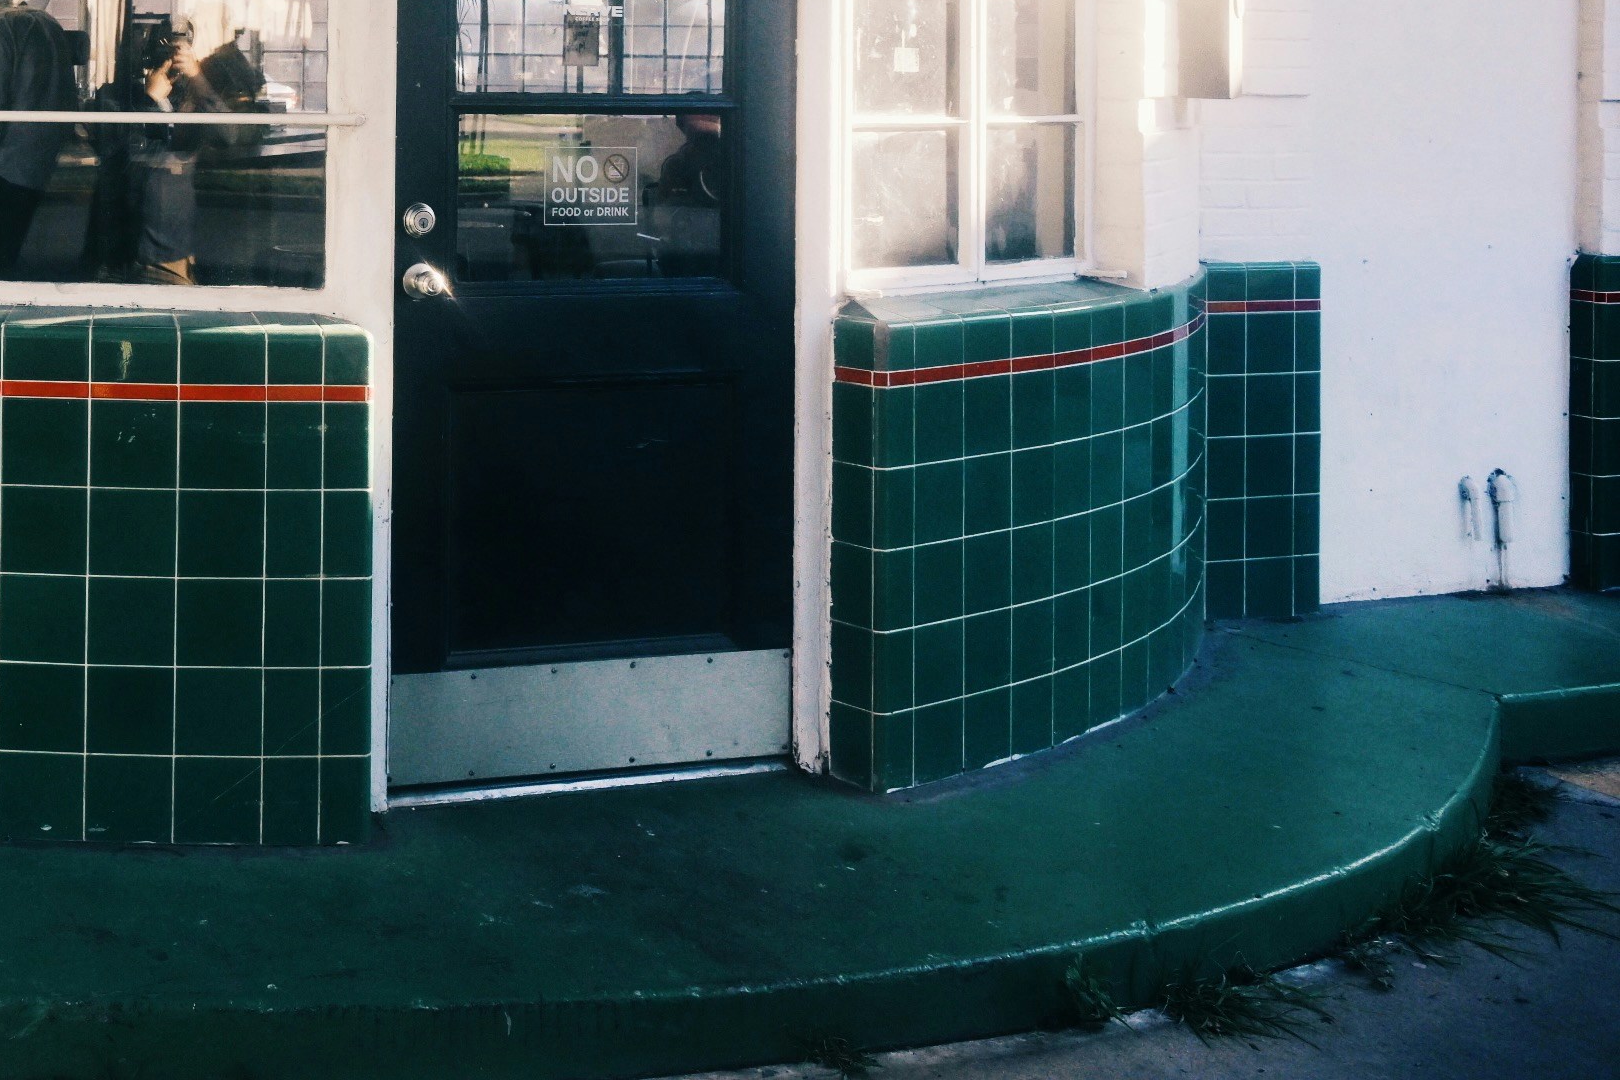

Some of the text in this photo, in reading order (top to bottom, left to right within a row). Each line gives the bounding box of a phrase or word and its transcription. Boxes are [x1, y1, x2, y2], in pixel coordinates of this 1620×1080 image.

[552, 155, 598, 183] NO
[551, 187, 630, 203] OUTSIDE
[552, 207, 629, 217] FOOD or DRINK
